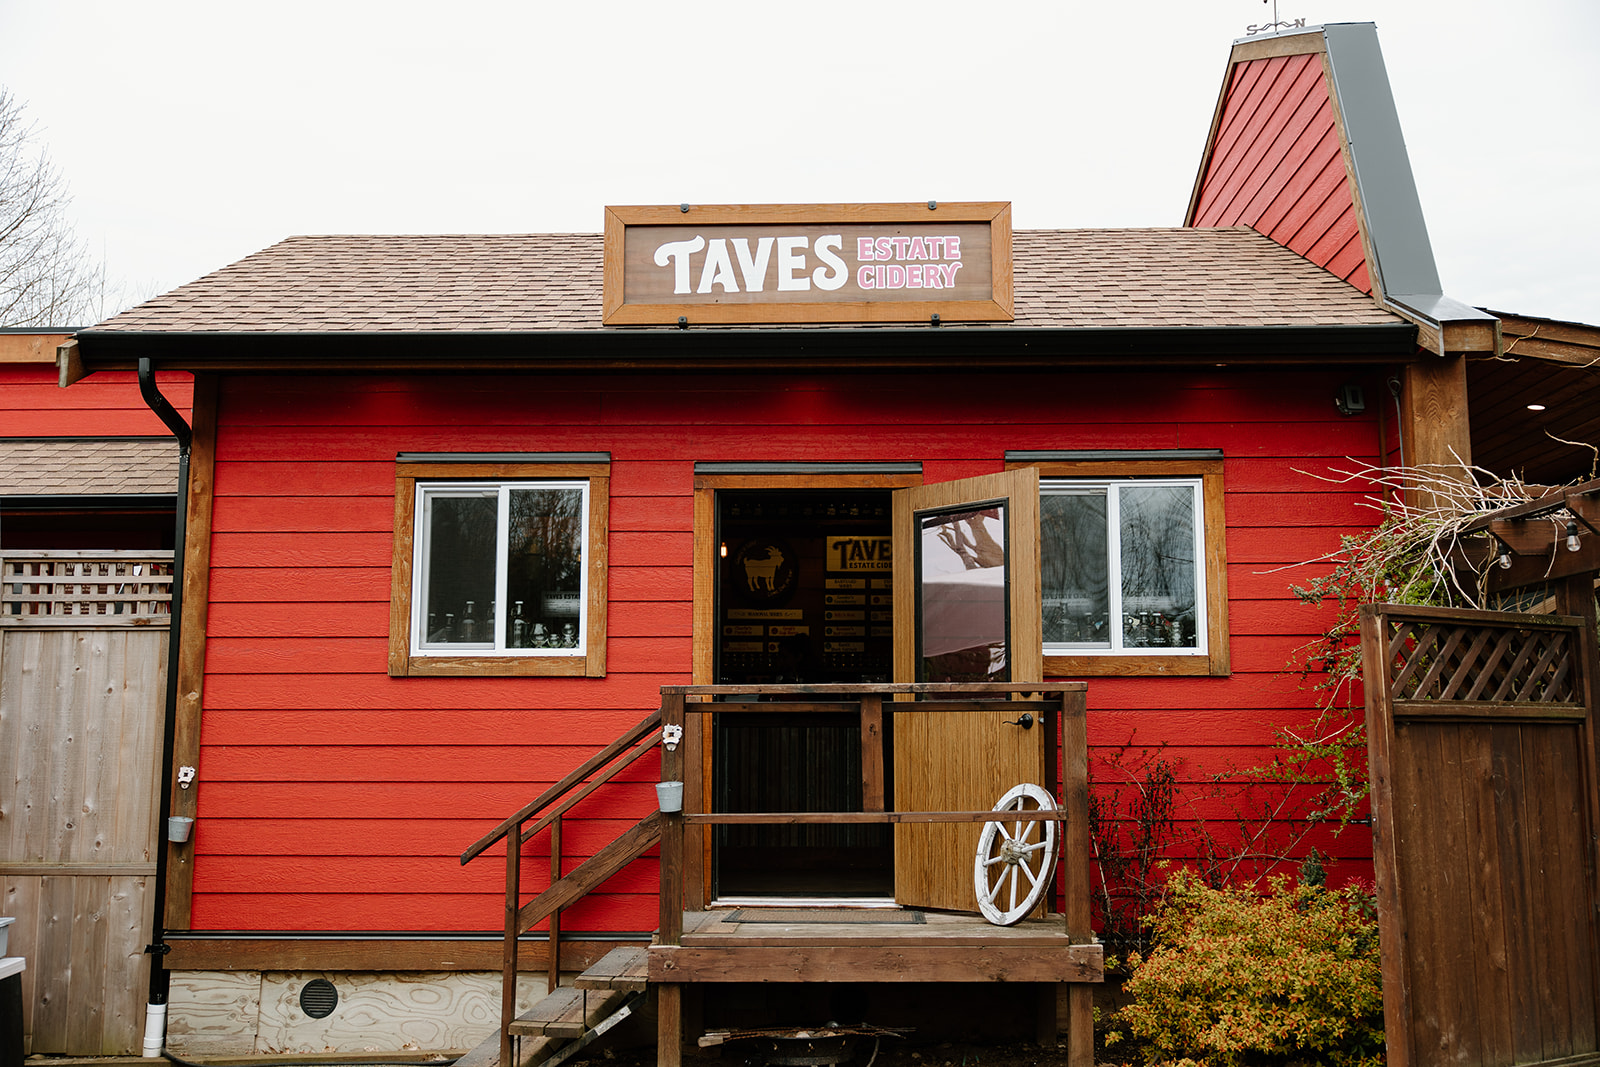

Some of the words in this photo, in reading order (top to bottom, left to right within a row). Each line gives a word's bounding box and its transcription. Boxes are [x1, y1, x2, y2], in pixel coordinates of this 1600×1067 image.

[856, 235, 962, 262] ESTATE
[653, 234, 849, 294] TAVES
[856, 262, 963, 290] CIDERY
[833, 538, 892, 569] TAVE
